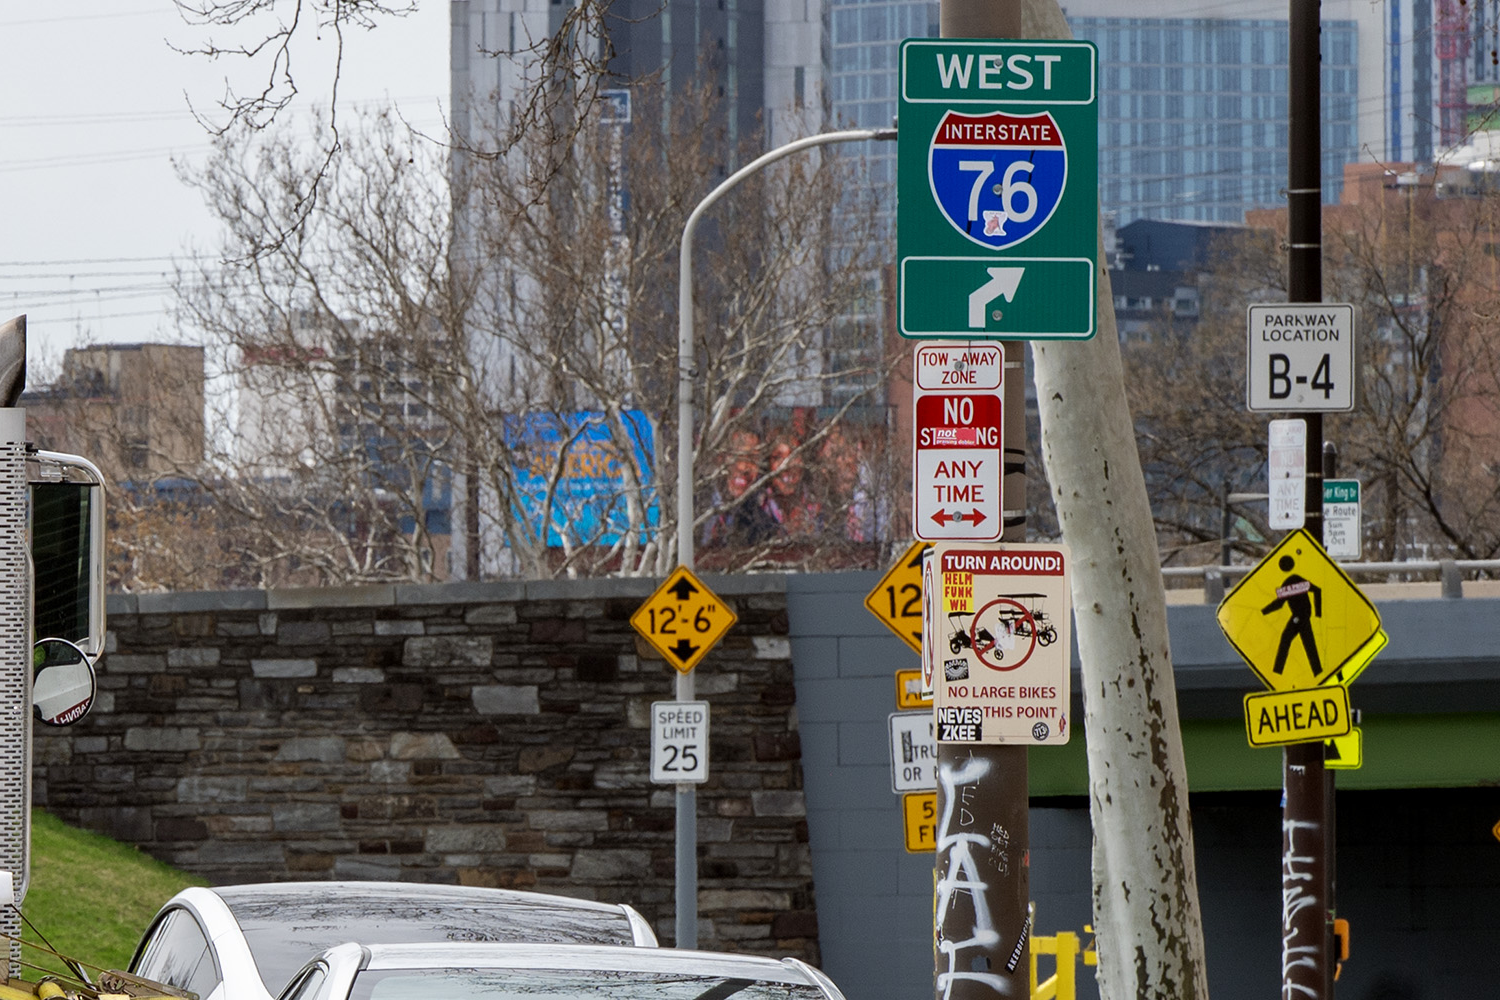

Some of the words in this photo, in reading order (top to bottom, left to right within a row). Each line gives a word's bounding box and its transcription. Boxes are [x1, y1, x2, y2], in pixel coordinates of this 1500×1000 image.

[936, 53, 1061, 90] WEST
[945, 124, 1051, 141] INTERSTATE
[958, 161, 1038, 224] 76
[1265, 314, 1337, 327] PARKWAY
[1263, 329, 1340, 342] LOCATION
[922, 353, 948, 367] TOW
[961, 352, 997, 366] AWAY
[941, 371, 977, 384] ZONE
[1269, 353, 1334, 400] B-4
[944, 397, 974, 425] NO
[937, 428, 957, 438] not
[934, 460, 984, 478] ANY
[933, 485, 984, 503] TIME
[1334, 486, 1349, 501] King
[1333, 506, 1357, 516] Route
[945, 555, 986, 570] TURN
[990, 556, 1061, 571] AROUND!
[945, 573, 972, 585] HELM
[945, 586, 972, 598] FUNK
[950, 599, 967, 611] WH
[948, 686, 968, 698] NO
[972, 686, 1015, 698] LARGE
[1019, 686, 1056, 699] BIKES
[659, 711, 703, 724] SPEED
[938, 708, 982, 724] NEVES
[983, 706, 1013, 718] THIS
[1017, 706, 1057, 718] POINT
[1258, 699, 1339, 735] AHEAD
[663, 727, 698, 740] LIMIT
[942, 725, 976, 740] ZKEE
[662, 745, 698, 772] 25
[903, 767, 921, 782] OR
